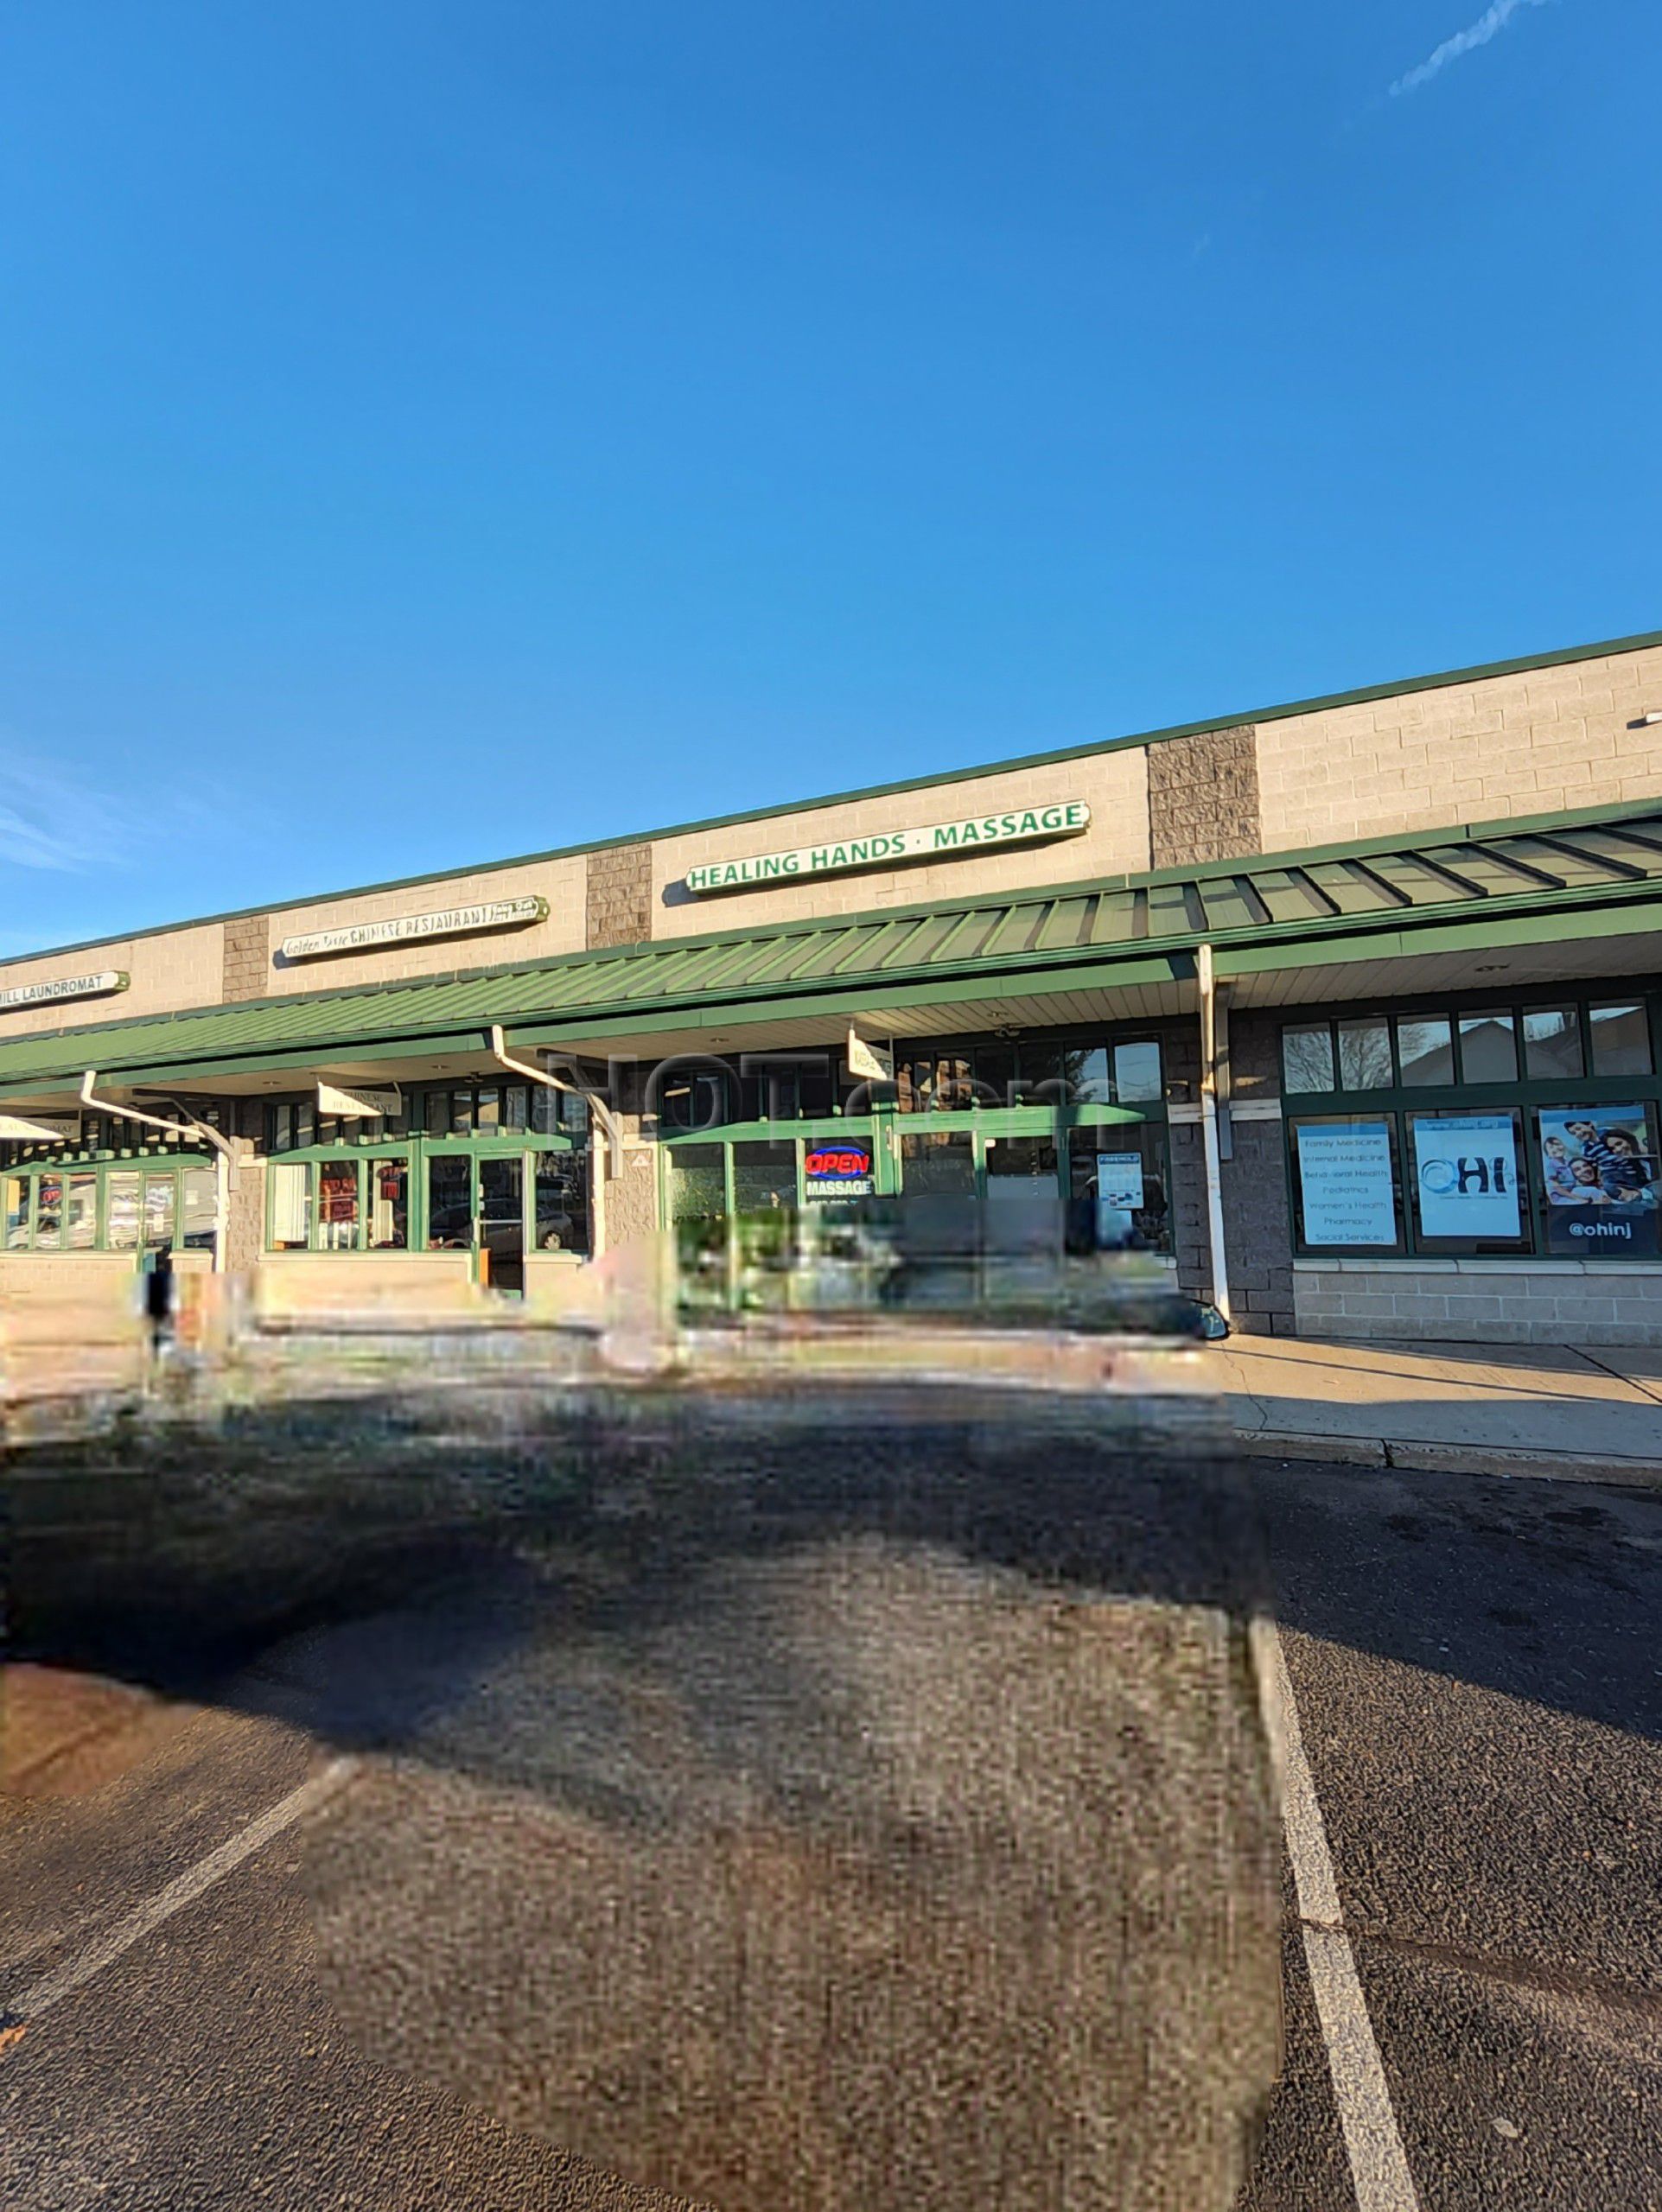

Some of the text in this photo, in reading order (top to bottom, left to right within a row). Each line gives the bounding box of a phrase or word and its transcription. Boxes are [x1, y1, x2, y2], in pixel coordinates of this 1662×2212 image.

[690, 804, 1084, 888] HEALING HANDS MASSAGE
[350, 920, 401, 944] CHINESE
[22, 976, 102, 1001] LAUNDROMAT
[1305, 1137, 1381, 1148] Family Medicine
[806, 1154, 869, 1174] OPEN
[1340, 1154, 1385, 1162] Medicine
[1355, 1169, 1387, 1178] Health
[806, 1180, 872, 1196] MASSAGE
[1324, 1217, 1372, 1225] Pharmacy
[1315, 1232, 1385, 1242] Social Services
[1570, 1223, 1632, 1239] @ohinj
